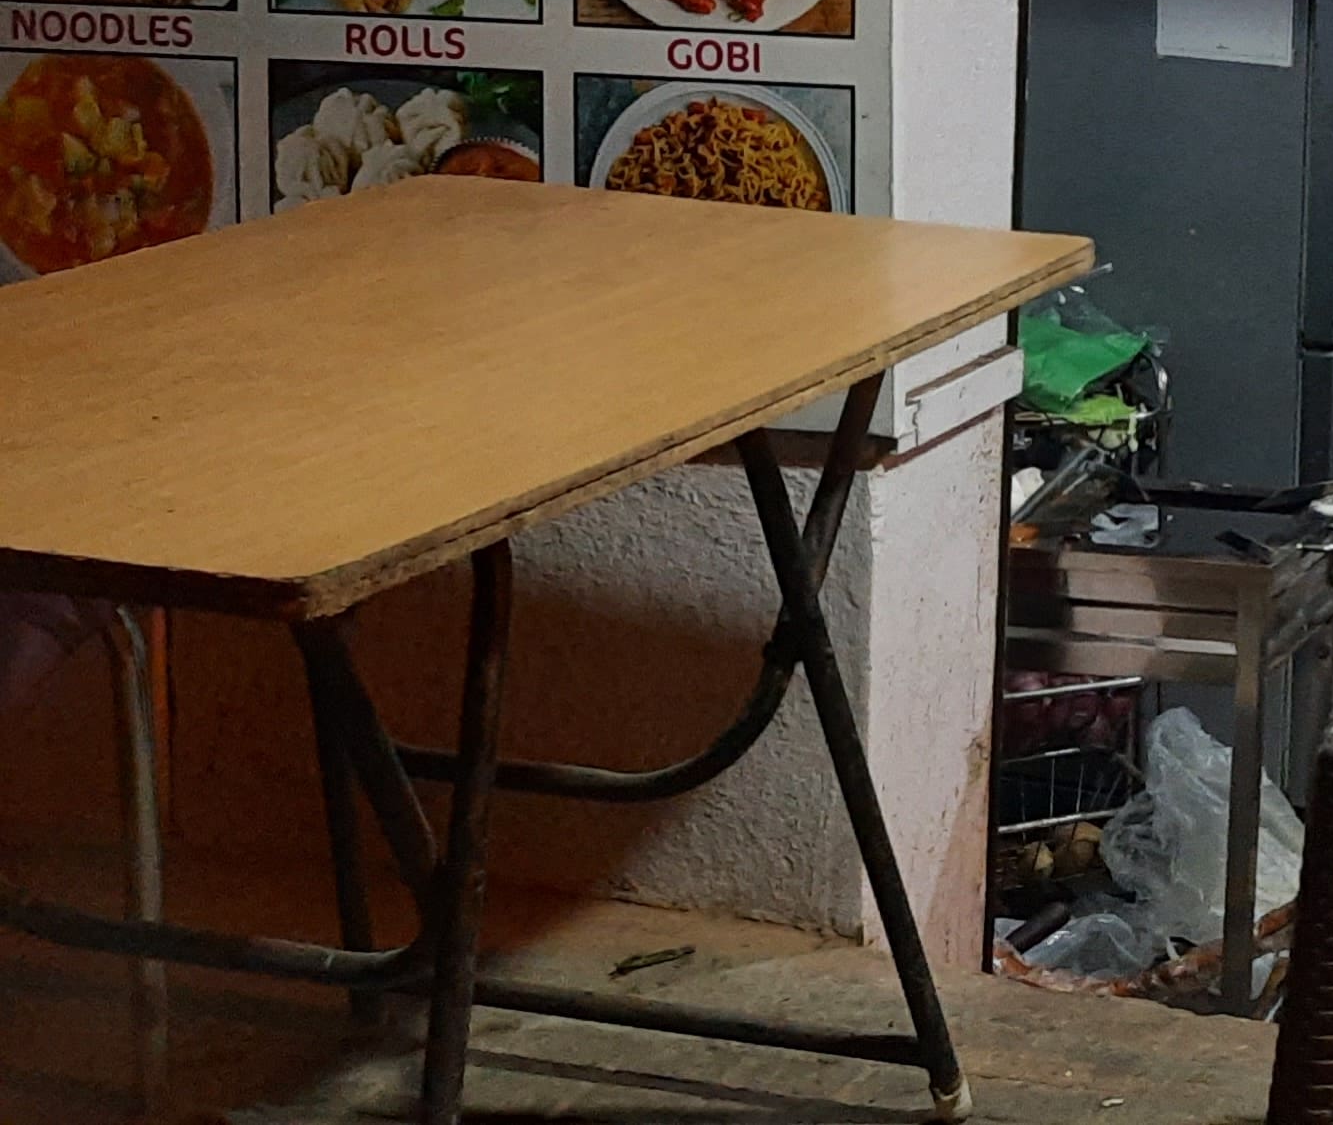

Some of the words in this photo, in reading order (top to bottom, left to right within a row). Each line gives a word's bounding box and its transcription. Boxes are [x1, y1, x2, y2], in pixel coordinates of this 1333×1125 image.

[11, 10, 193, 51] NOODLES
[344, 22, 466, 61] ROLLS
[666, 37, 762, 75] GOBI
